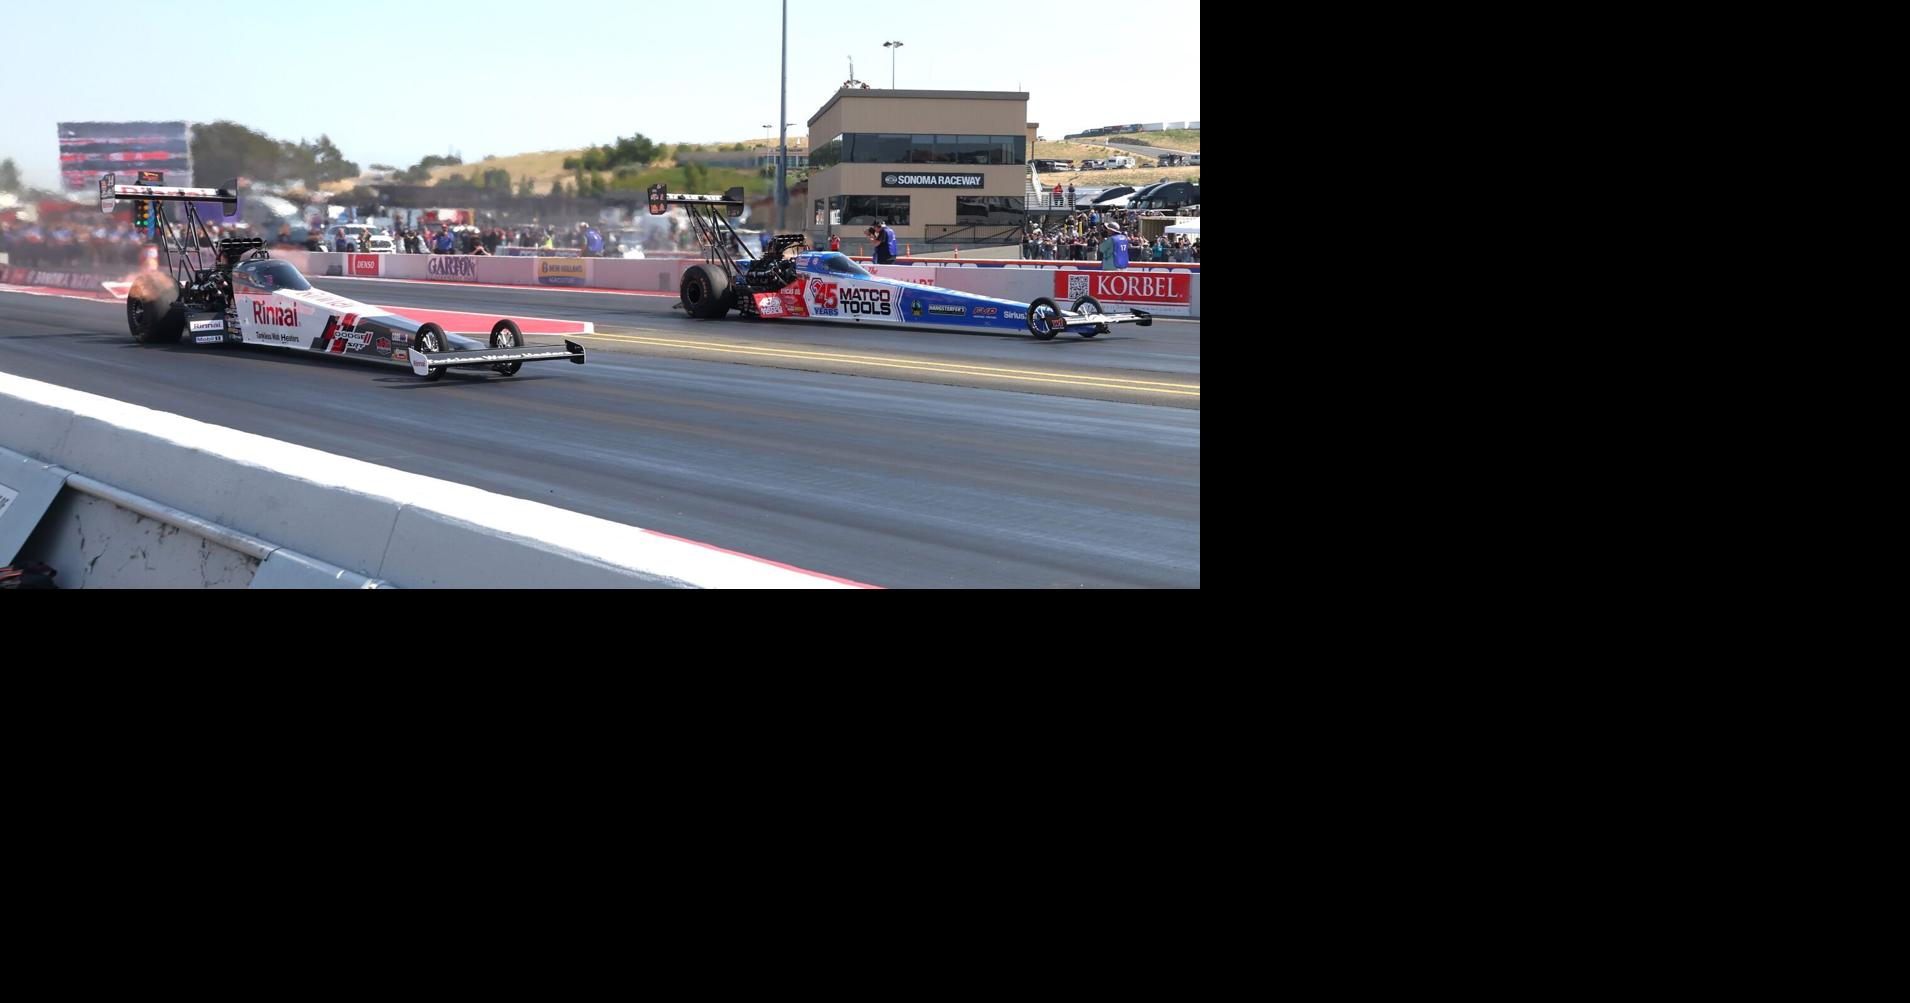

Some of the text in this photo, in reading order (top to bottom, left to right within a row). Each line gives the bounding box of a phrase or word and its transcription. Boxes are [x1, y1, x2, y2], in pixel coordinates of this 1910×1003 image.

[898, 175, 981, 186] SONOMA RACEWAY
[356, 260, 375, 269] DENSO
[1097, 275, 1178, 298] KORBEL
[814, 282, 839, 308] 45
[840, 288, 891, 302] MATCO
[252, 300, 298, 327] Rinnai
[814, 308, 839, 316] YEARS
[840, 301, 891, 316] TOOLS
[334, 332, 366, 340] DODGE
[347, 342, 366, 350] SRT
